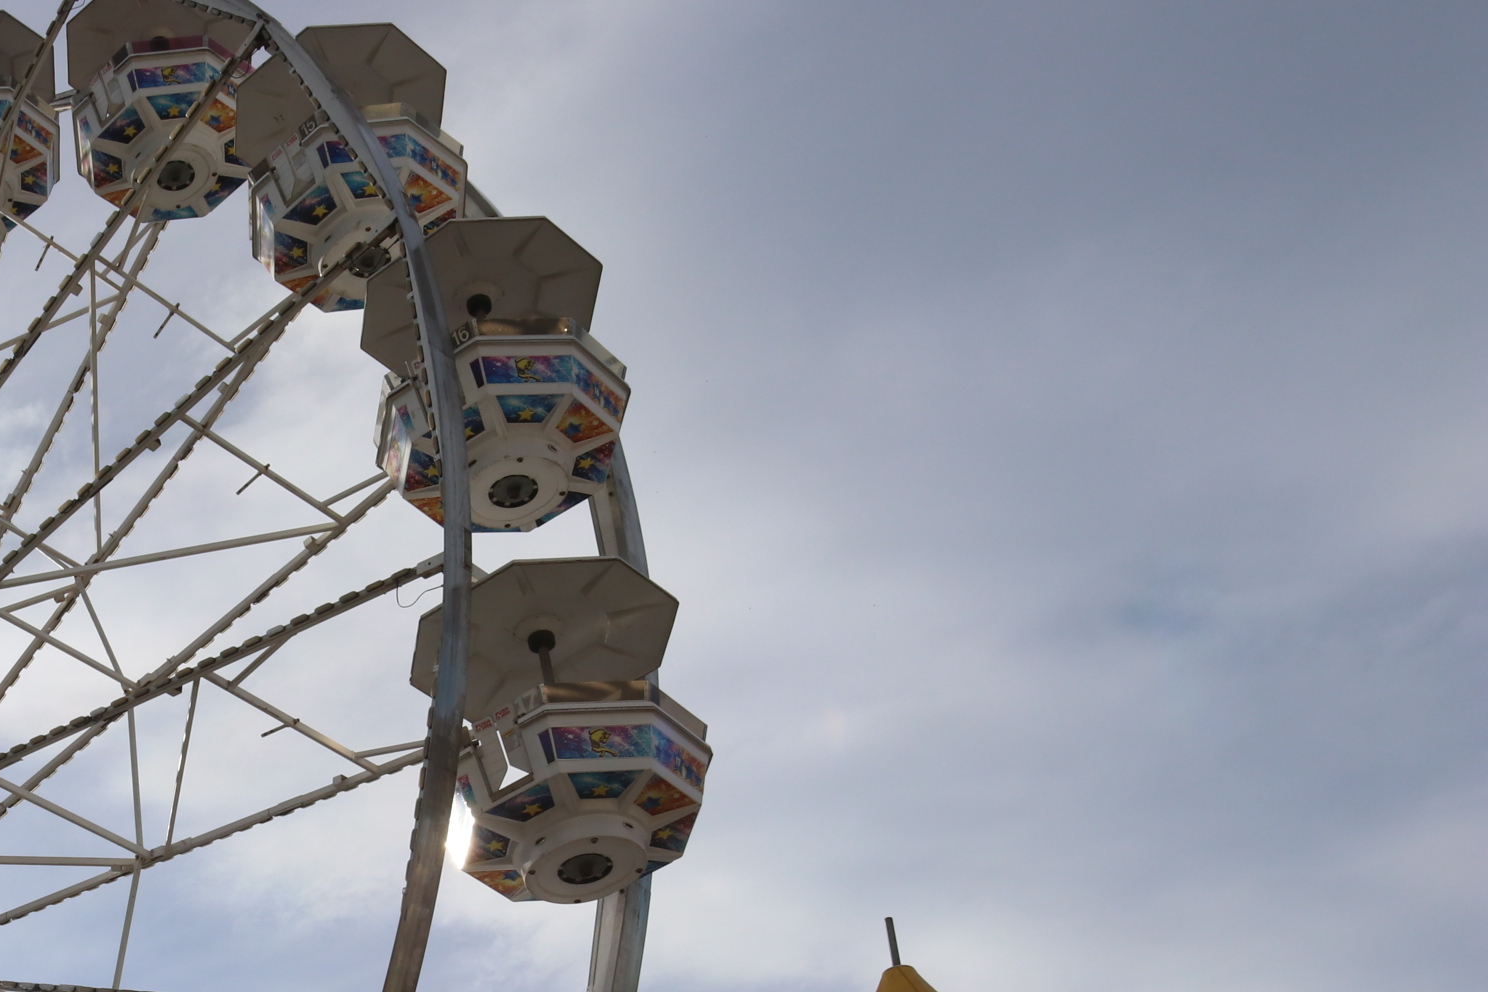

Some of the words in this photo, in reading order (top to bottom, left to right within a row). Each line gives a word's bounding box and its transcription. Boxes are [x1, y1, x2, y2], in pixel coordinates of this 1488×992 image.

[301, 120, 316, 135] 15
[452, 326, 469, 345] 16
[514, 687, 537, 714] 17
[495, 706, 509, 716] PUSH
[475, 719, 490, 729] PUSH
